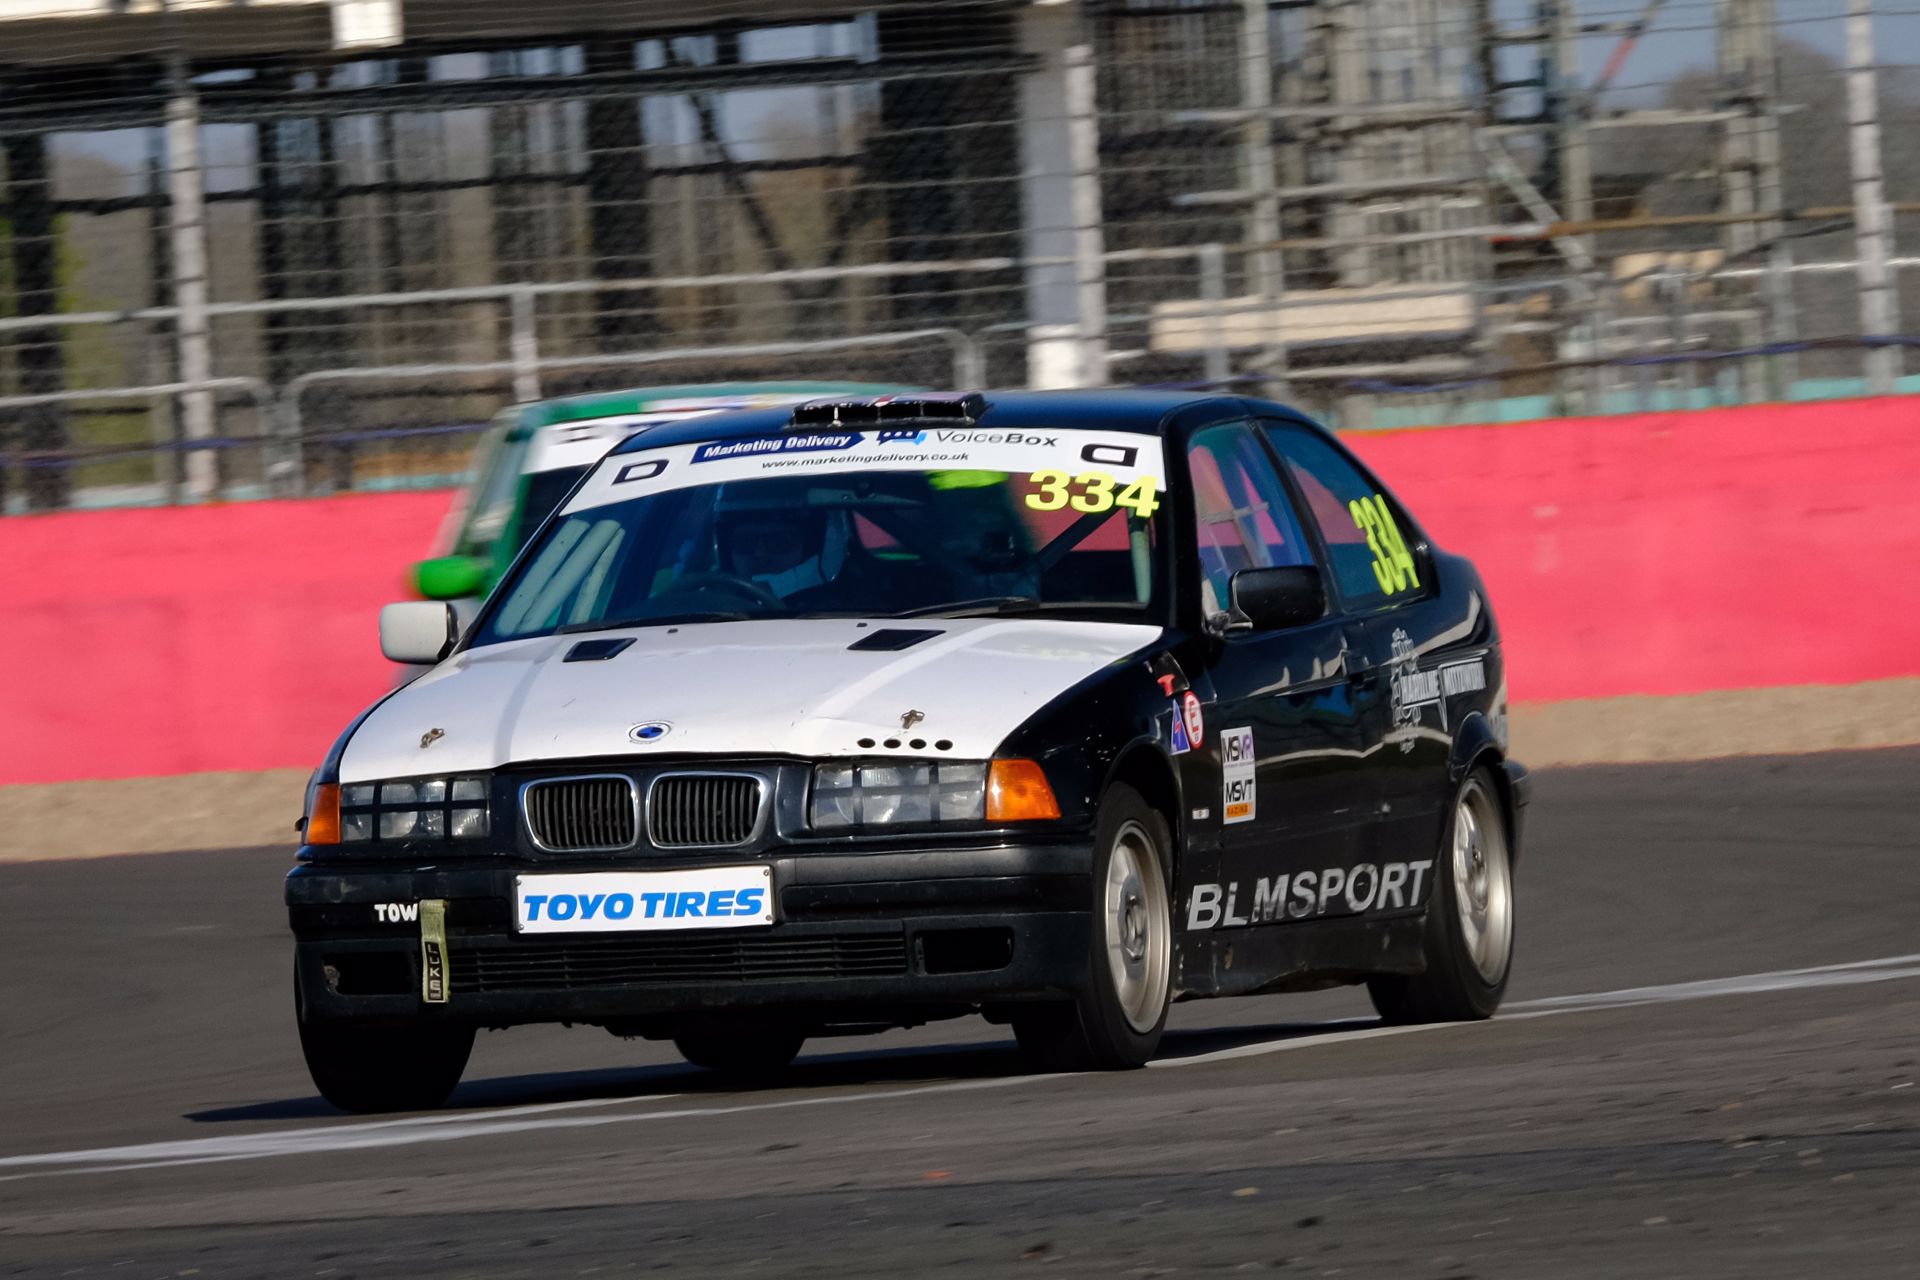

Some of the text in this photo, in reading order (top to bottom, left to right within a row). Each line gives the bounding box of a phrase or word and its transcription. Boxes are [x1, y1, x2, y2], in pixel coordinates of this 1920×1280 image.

[703, 434, 851, 458] Marketing Delivery
[936, 430, 1059, 447] VoiceBox
[762, 452, 969, 469] www.marketingdelivery.co.uk
[1024, 469, 1160, 518] 334
[1348, 493, 1421, 596] 334
[1225, 778, 1254, 803] MSVT
[523, 888, 764, 921] TOYO TIRES
[1186, 859, 1432, 931] BLMSPORT
[374, 903, 418, 923] TOW
